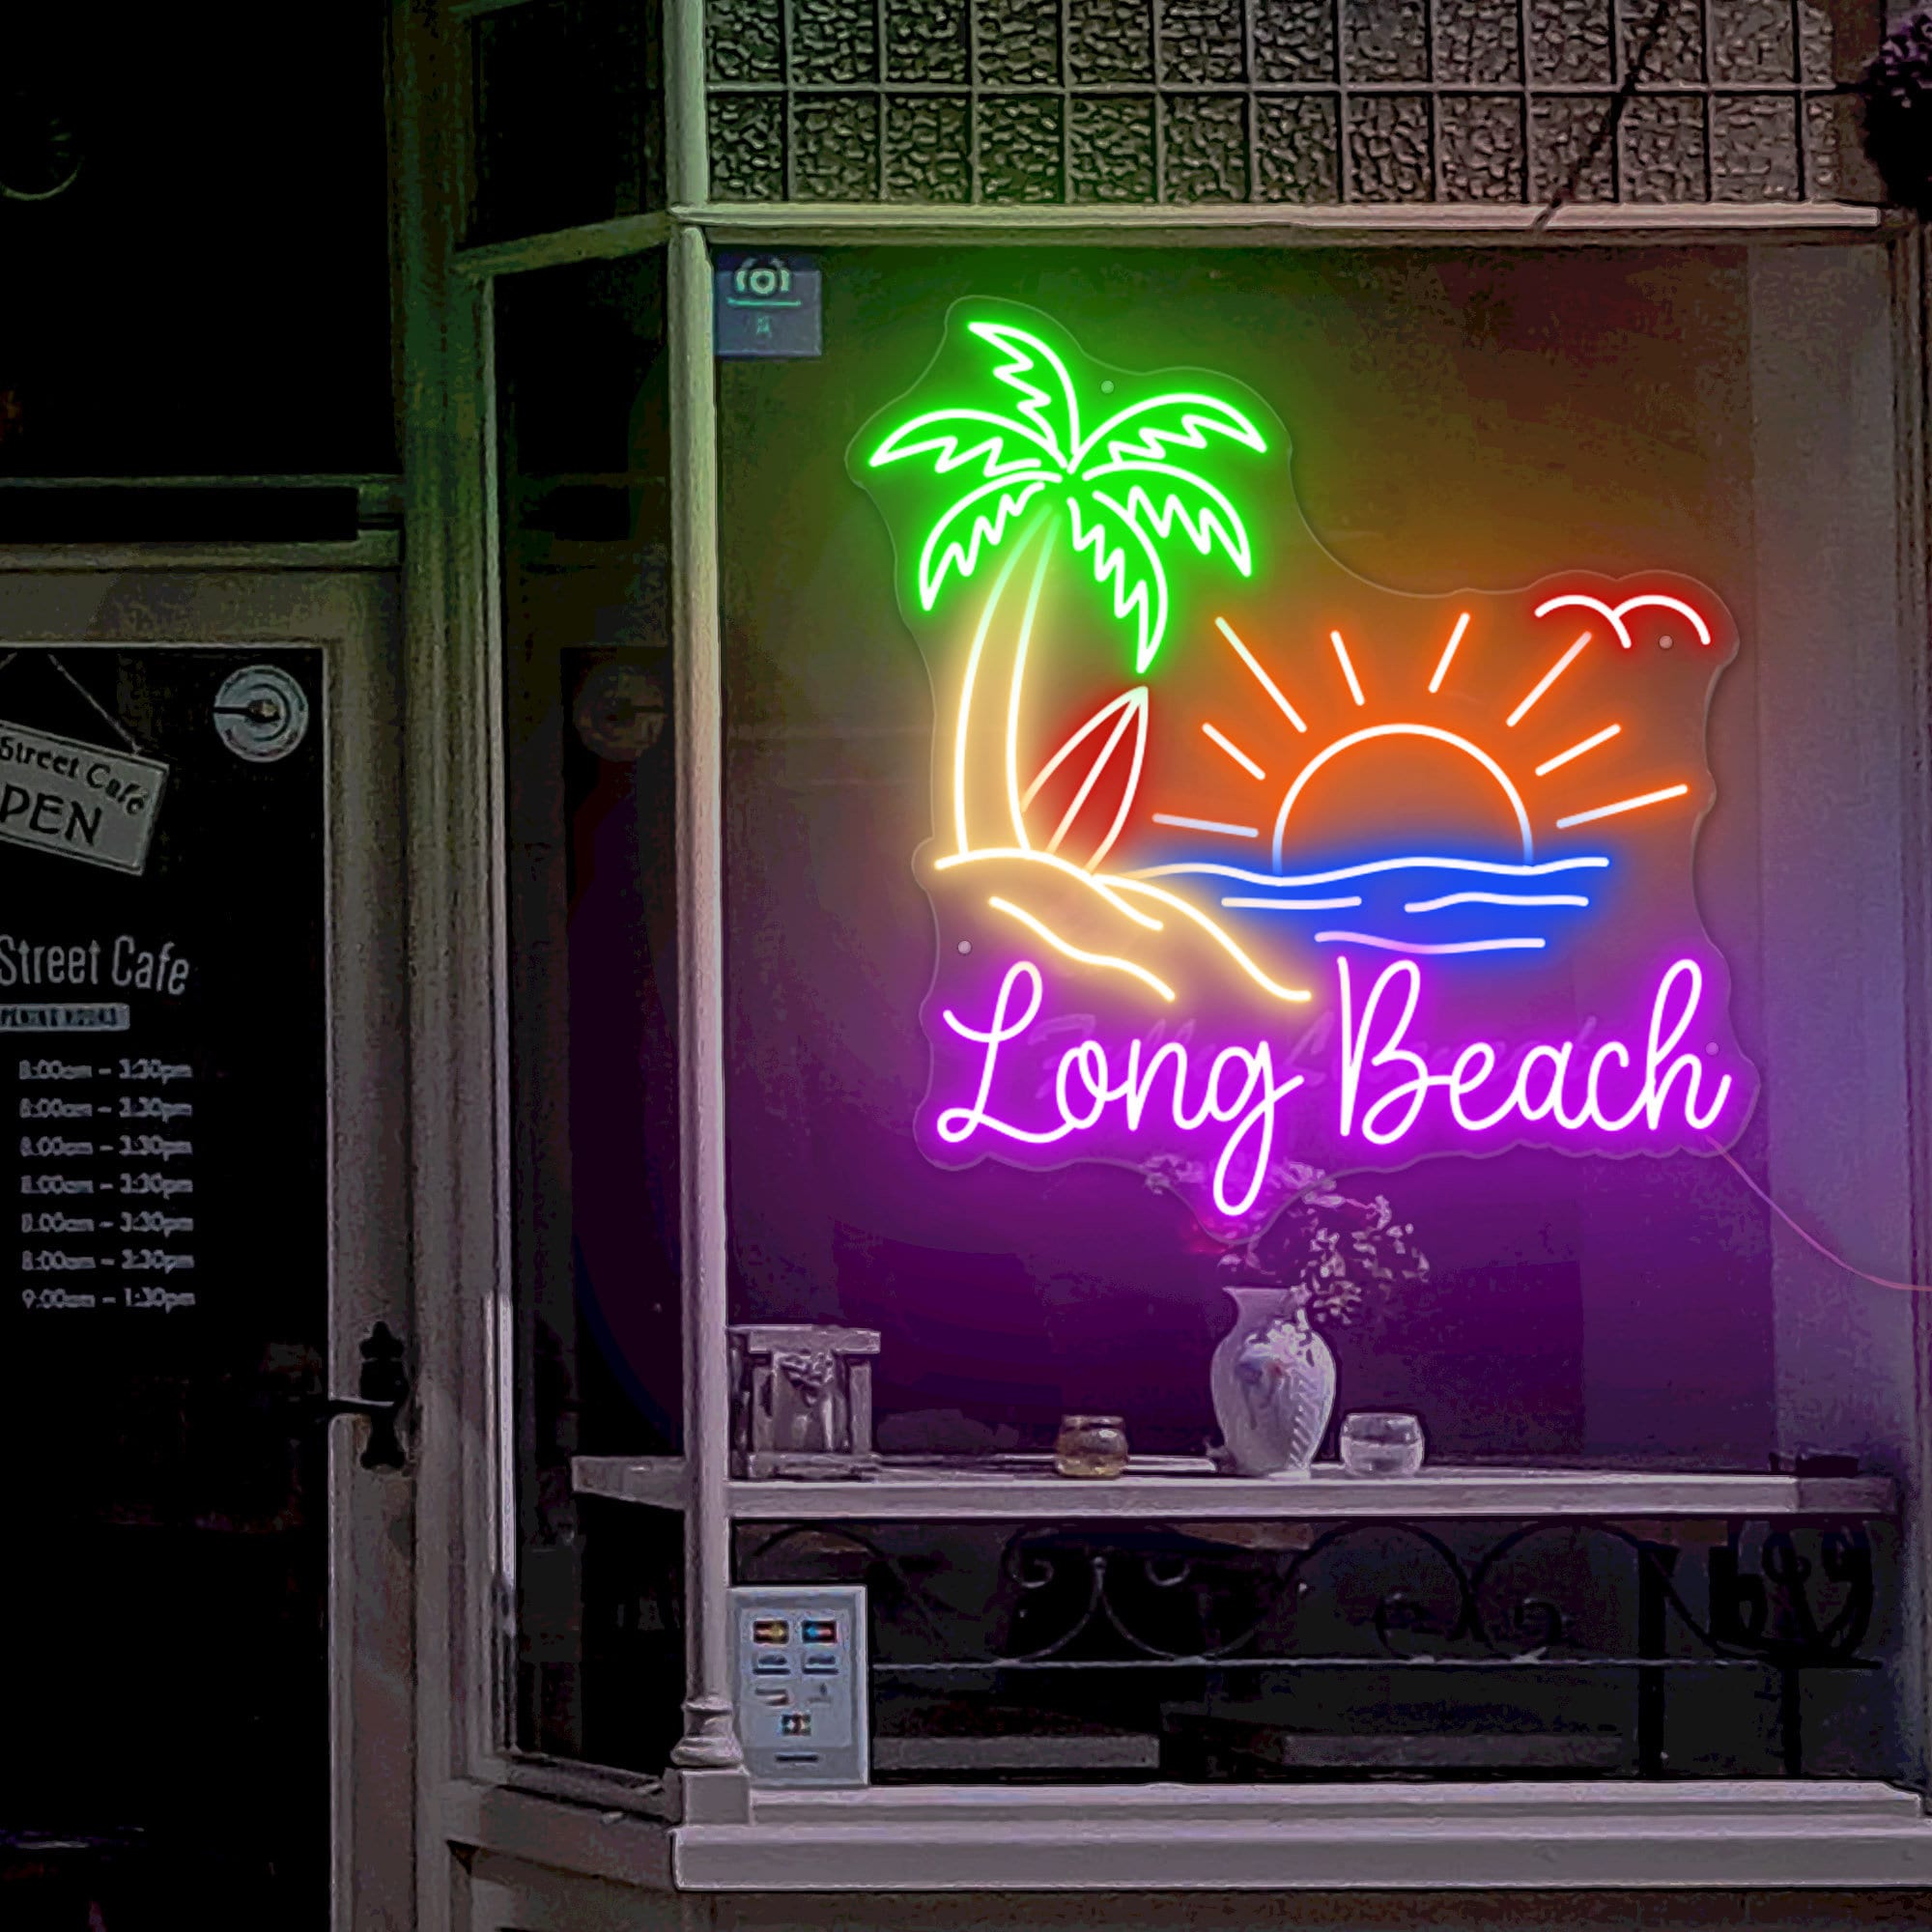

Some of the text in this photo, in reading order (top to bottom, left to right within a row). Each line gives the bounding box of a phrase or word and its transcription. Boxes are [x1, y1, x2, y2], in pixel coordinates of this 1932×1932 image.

[0, 736, 79, 779] Street
[0, 935, 189, 995] Street Cafe
[937, 960, 1304, 1216] Long
[1339, 957, 1732, 1147] Beach
